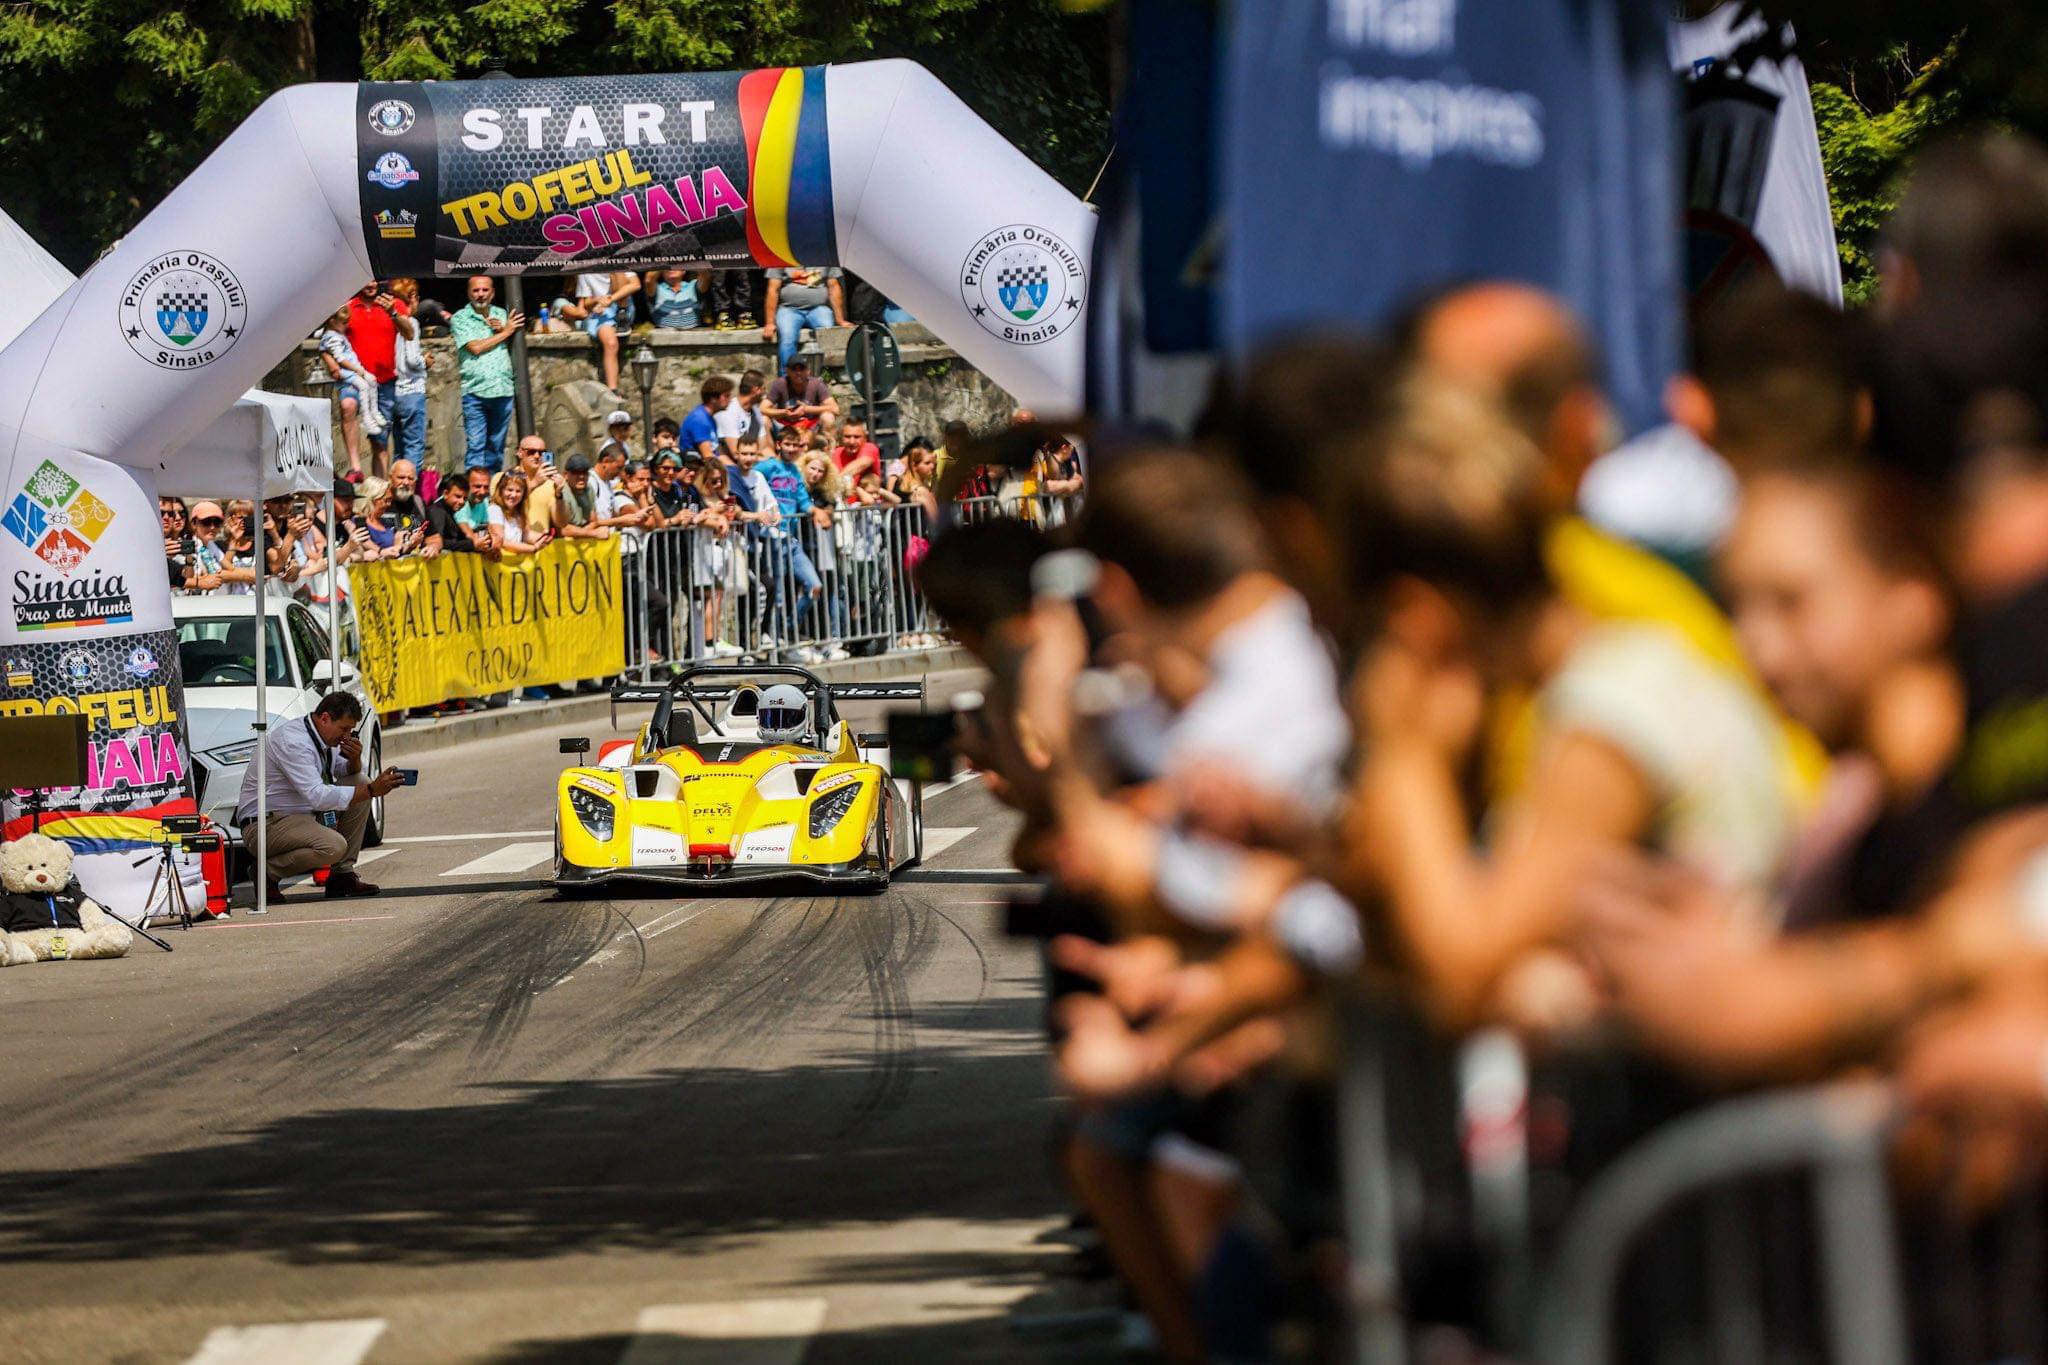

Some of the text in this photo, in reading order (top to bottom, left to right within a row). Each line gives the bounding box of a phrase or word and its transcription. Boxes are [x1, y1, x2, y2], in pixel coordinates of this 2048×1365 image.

[461, 99, 715, 151] START
[440, 149, 653, 237] TROFEUL
[541, 165, 748, 254] SINAIA
[124, 254, 244, 308] Primăria Orașului
[965, 228, 1082, 286] Primăria Orașului
[1003, 323, 1058, 342] Sinaia
[156, 350, 215, 367] Sinaia
[12, 568, 128, 605] Sinaia
[56, 603, 76, 620] de
[80, 600, 132, 617] Munte
[402, 556, 614, 640] ALEXANDRION
[465, 642, 533, 687] GROUP
[693, 807, 732, 815] DELTA
